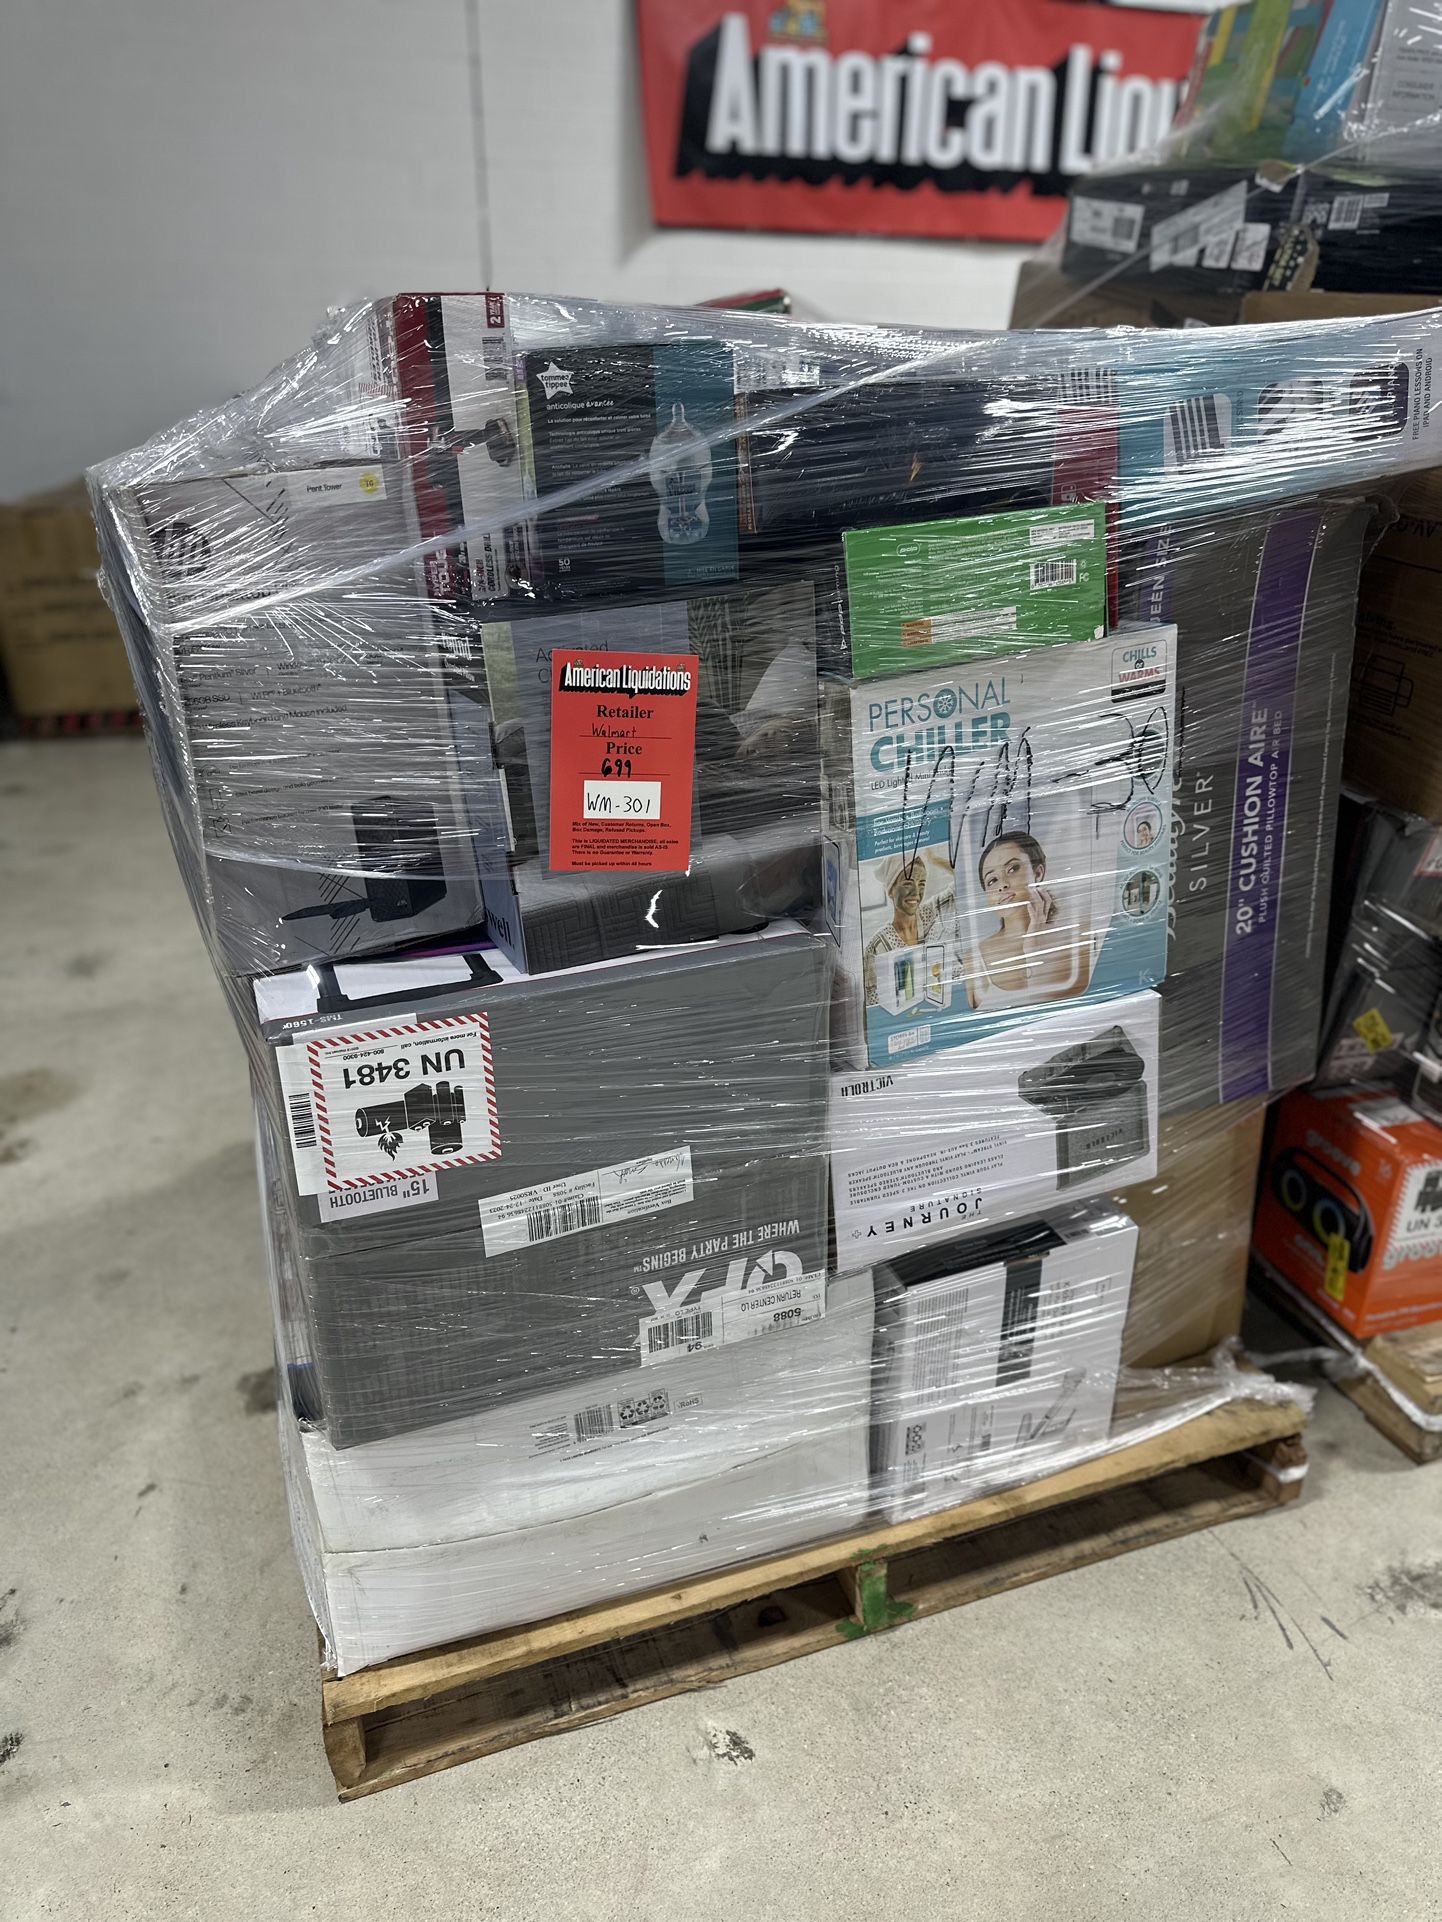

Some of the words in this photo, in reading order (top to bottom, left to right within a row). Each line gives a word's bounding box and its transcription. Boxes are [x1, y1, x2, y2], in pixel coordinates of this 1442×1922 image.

[705, 13, 1057, 173] American
[547, 402, 585, 410] anticolique
[1123, 646, 1157, 662] CHILLS
[564, 662, 620, 688] American
[622, 665, 691, 693] Liquidations
[597, 705, 654, 718] Retailer
[868, 676, 1010, 732] PERSONAL
[592, 723, 636, 737] Walmart
[1273, 710, 1282, 736] BED
[606, 742, 642, 754] Price
[870, 712, 1012, 774] CHILLER
[1271, 739, 1281, 759] AIR
[871, 781, 885, 790] LED
[1266, 762, 1279, 831] PILLOWTOP
[1189, 774, 1214, 892] SILVER
[1238, 775, 1262, 892] CUSHION
[1261, 833, 1273, 885] QUILTED
[1235, 899, 1254, 935] 20"
[1258, 894, 1268, 924] PLUSH
[400, 1042, 412, 1050] call
[413, 1035, 448, 1047] information,
[449, 1032, 466, 1041] more
[421, 1048, 466, 1076] UN
[343, 1058, 411, 1089] 3481
[330, 1183, 398, 1209] BLUETOOTH
[403, 1178, 430, 1199] 15"
[555, 1182, 566, 1191] User
[577, 1181, 595, 1193] Facility
[910, 1187, 982, 1212] SIGNATURE
[866, 1197, 982, 1238] JOURNEY
[1406, 1219, 1430, 1233] UN
[731, 1226, 755, 1247] THE
[757, 1219, 800, 1242] WHERE
[691, 1233, 729, 1259] PARTY
[751, 1294, 775, 1309] CENTER
[775, 1289, 801, 1304] RETURN
[773, 1307, 802, 1322] 5088
[687, 1341, 702, 1352] 94
